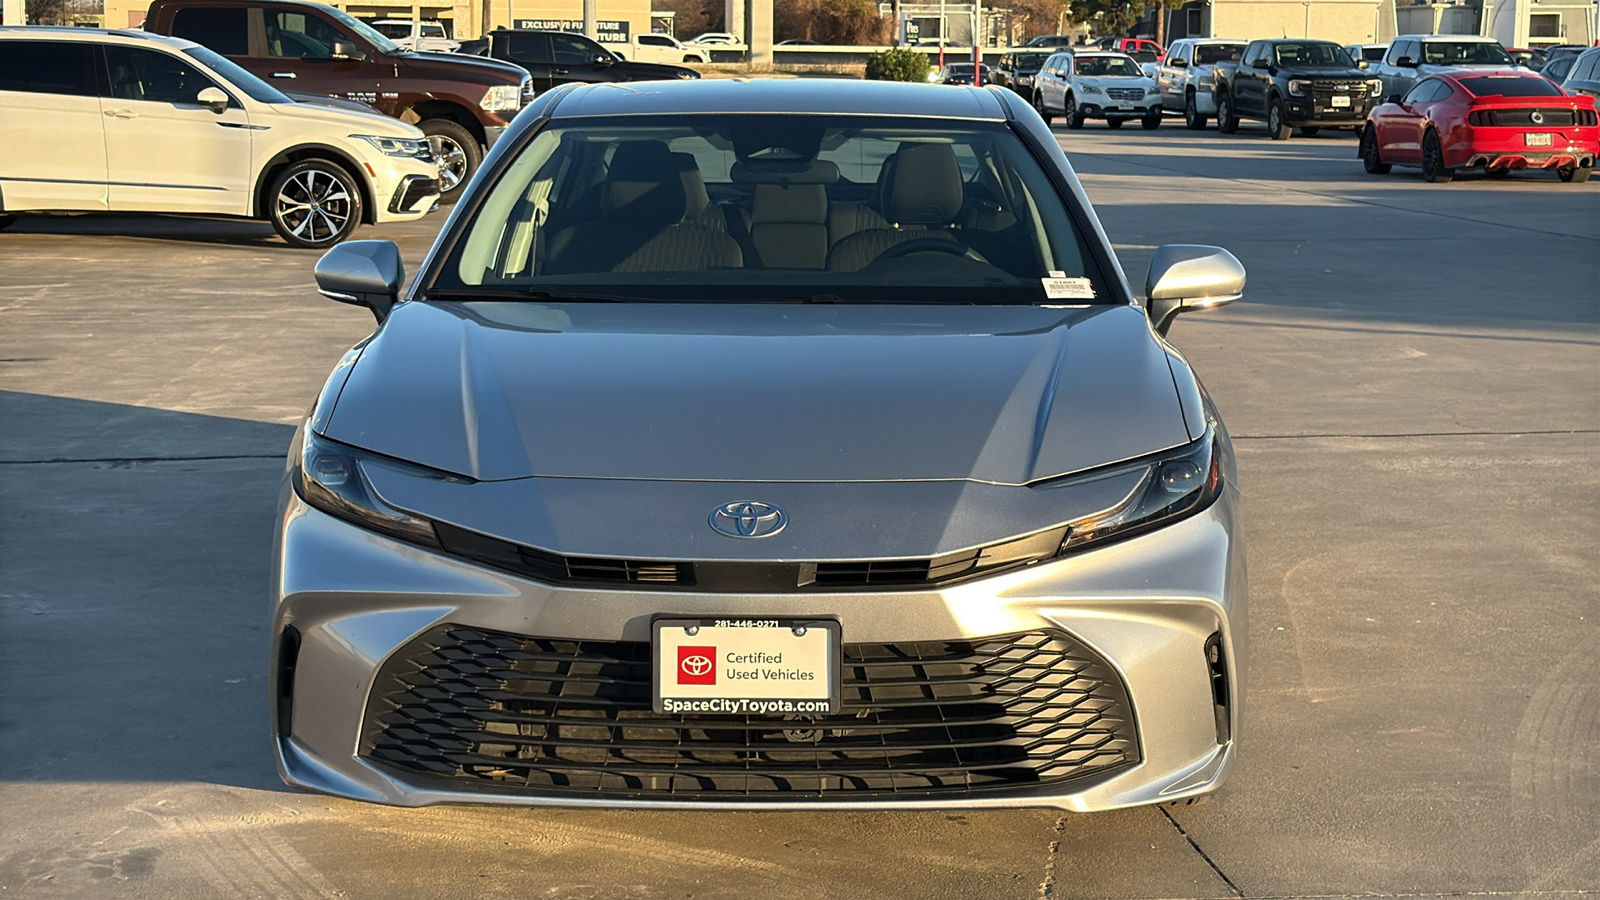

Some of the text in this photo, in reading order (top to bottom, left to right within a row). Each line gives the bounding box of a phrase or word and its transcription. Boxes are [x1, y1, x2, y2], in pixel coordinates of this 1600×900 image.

[714, 620, 779, 628] 281-446-0271
[726, 652, 782, 664] Certified
[726, 669, 815, 681] Used Vehicles
[663, 698, 830, 714] SpaceCityToyota.com
